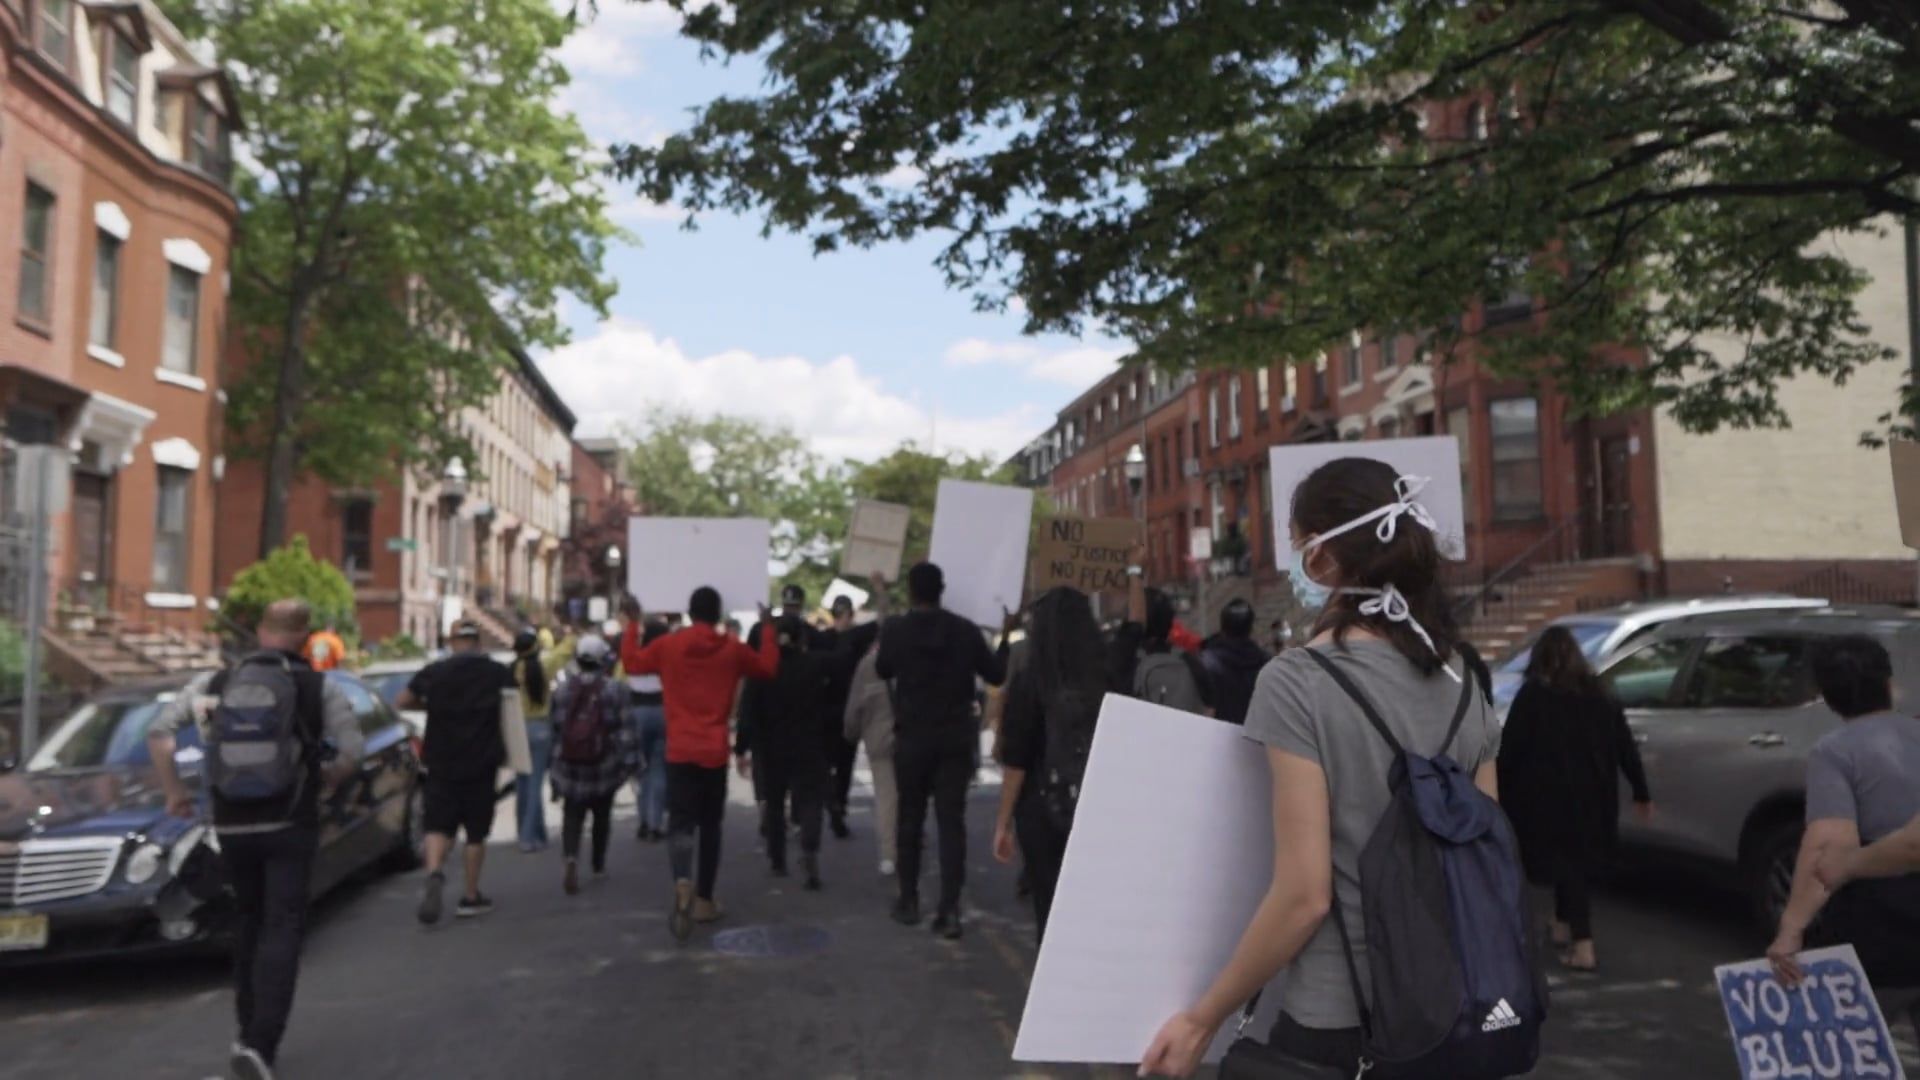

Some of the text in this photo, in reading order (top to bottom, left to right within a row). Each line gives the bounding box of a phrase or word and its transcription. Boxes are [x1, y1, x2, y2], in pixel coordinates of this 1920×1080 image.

[1051, 519, 1084, 542] NO
[1050, 560, 1075, 579] NO
[1731, 972, 1869, 1026] VOTE
[1481, 1016, 1521, 1032] adidas
[1741, 1027, 1891, 1079] BLUE
